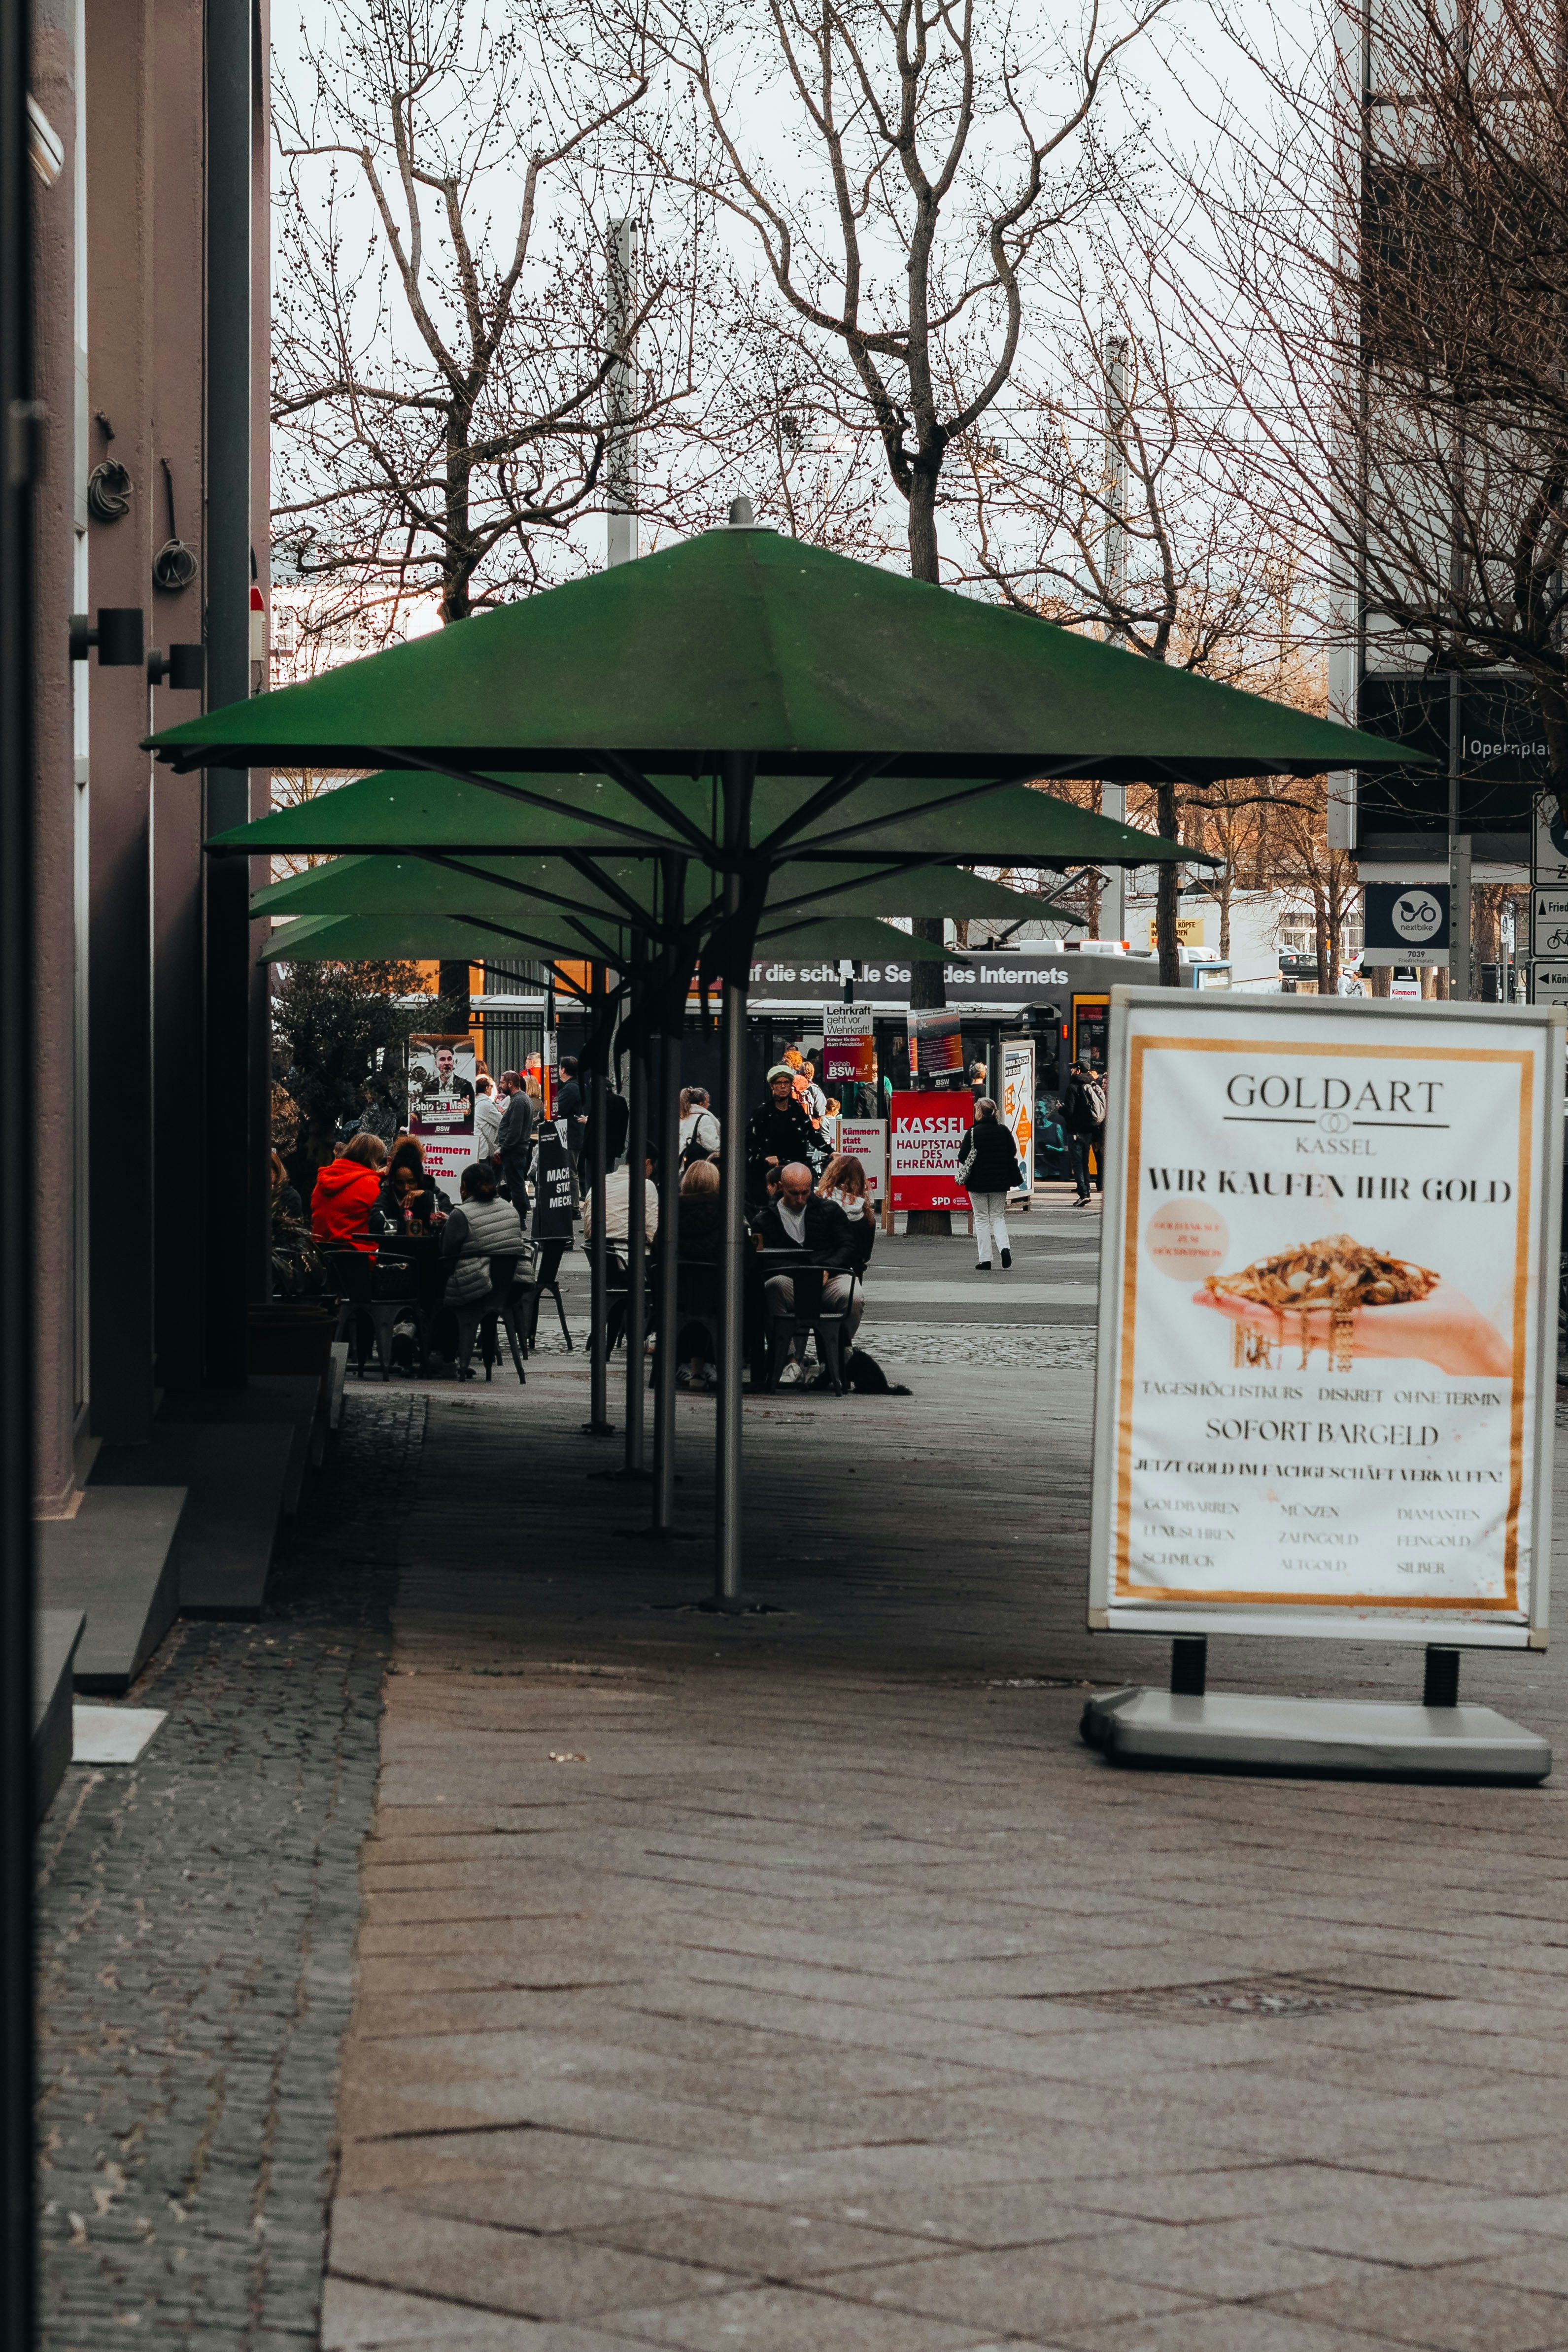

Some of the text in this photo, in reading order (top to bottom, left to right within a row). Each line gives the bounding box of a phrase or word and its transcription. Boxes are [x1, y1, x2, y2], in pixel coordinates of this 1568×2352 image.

[1558, 864, 1568, 879] Z
[765, 964, 796, 982] die
[943, 965, 976, 984] des
[980, 965, 1069, 985] Internets
[826, 1006, 871, 1015] Lehrkraft
[826, 1016, 847, 1026] geht
[827, 1025, 870, 1034] Wehrkraft!
[829, 1066, 855, 1077] BSW
[1227, 1073, 1445, 1114] GOLDART
[411, 1099, 470, 1111] Fabio De Masi
[896, 1117, 968, 1134] KASSEL
[922, 1149, 942, 1159] DES
[1295, 1136, 1378, 1157] KASSEL
[424, 1156, 443, 1165] tatt
[424, 1166, 457, 1178] ürzen.
[1148, 1167, 1512, 1203] WIR KAUFEN IHR GOLD
[549, 1195, 572, 1208] MECK
[931, 1196, 951, 1205] SPD
[1142, 1380, 1501, 1406] TAGESHÖCHSTKURS DISKRET OHNE TERMIN
[1205, 1417, 1439, 1446] SOFORT BARGELD
[1134, 1459, 1503, 1483] JETZT GOLD IM FACHGESCHÄFT VERKAUFEN!
[1143, 1498, 1481, 1521] GOLDBARREN MÜNZEN DIAMANTEN
[1279, 1531, 1360, 1546] ZAHNGOLD
[1397, 1534, 1472, 1547] FEINGOLD
[1142, 1552, 1446, 1574] SCHMUCK ALTGOLD SILBER
